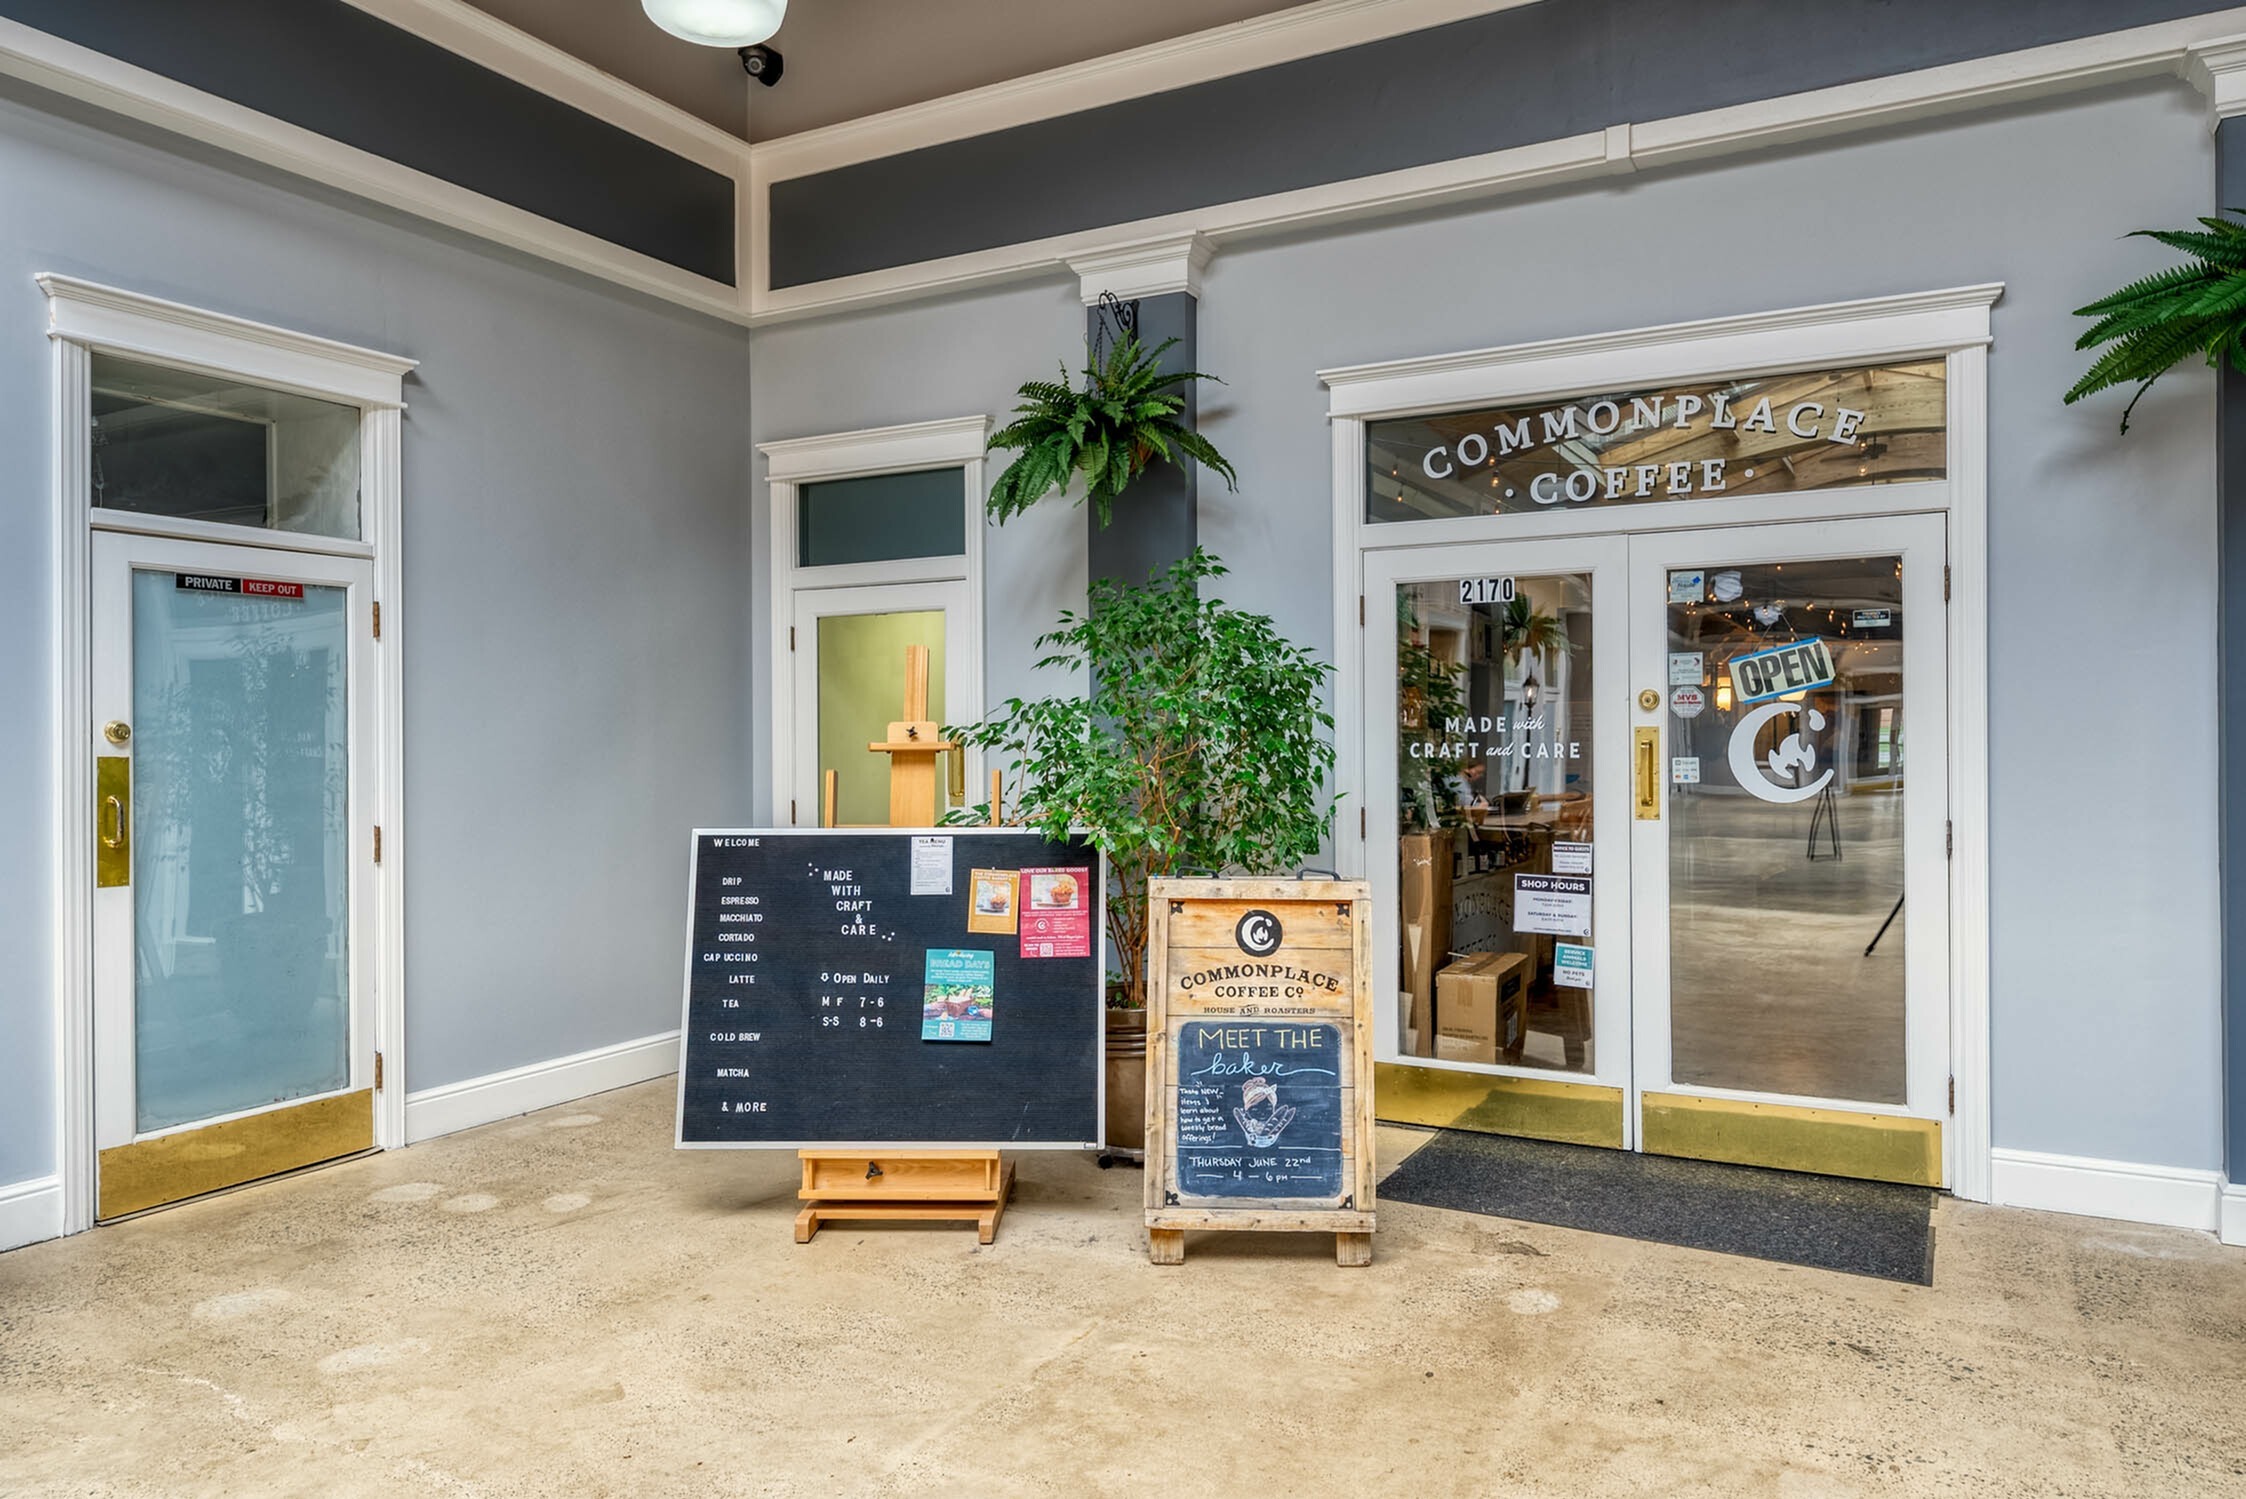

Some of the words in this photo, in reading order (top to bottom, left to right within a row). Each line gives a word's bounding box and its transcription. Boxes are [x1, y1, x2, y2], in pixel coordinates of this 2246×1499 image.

[1422, 394, 1866, 480] COMMONPLACE
[1529, 457, 1726, 505] COFFEE
[185, 576, 233, 591] PRIVATE
[248, 582, 275, 593] KEEP
[277, 584, 297, 595] OUT
[1461, 578, 1513, 603] 2170
[1738, 643, 1829, 697] OPEN
[1445, 716, 1507, 733] MADE
[1512, 714, 1545, 731] with
[1409, 742, 1480, 759] CRAFT
[1485, 741, 1514, 757] and
[1521, 742, 1581, 759] CARE
[713, 838, 760, 847] WELCOME
[823, 870, 853, 881] MADE
[722, 877, 742, 886] DRIP
[1521, 879, 1549, 889] SHOP
[1550, 881, 1585, 892] HOURS
[831, 885, 861, 896] WITH
[721, 896, 760, 905] ESPRESSO
[836, 900, 872, 911] CRAFT
[719, 913, 763, 922] MACCHIATO
[855, 914, 863, 924] &
[841, 924, 877, 935] CARE
[718, 933, 755, 942] CORTADO
[729, 975, 755, 984] LATTE
[1180, 963, 1339, 993] COMMONPLACE
[1215, 986, 1279, 998] COFFEE
[722, 999, 739, 1008] TEA
[1203, 1006, 1236, 1014] HOUSE
[1239, 1005, 1260, 1016] AND
[1264, 1007, 1316, 1015] ROASTERS
[710, 1033, 736, 1042] COLD
[738, 1033, 761, 1042] BREW
[1199, 1027, 1267, 1050] MEET
[1274, 1028, 1323, 1049] THE
[1192, 1052, 1312, 1076] baker
[717, 1069, 749, 1078] MATCHA
[1200, 1087, 1219, 1095] NEW
[721, 1101, 729, 1112] &
[735, 1102, 767, 1112] MORE
[1189, 1156, 1242, 1168] THURSDAY
[1248, 1157, 1278, 1168] JUNE
[1285, 1156, 1311, 1168] 22nd
[1233, 1170, 1242, 1181] 4
[1265, 1171, 1274, 1182] 6
